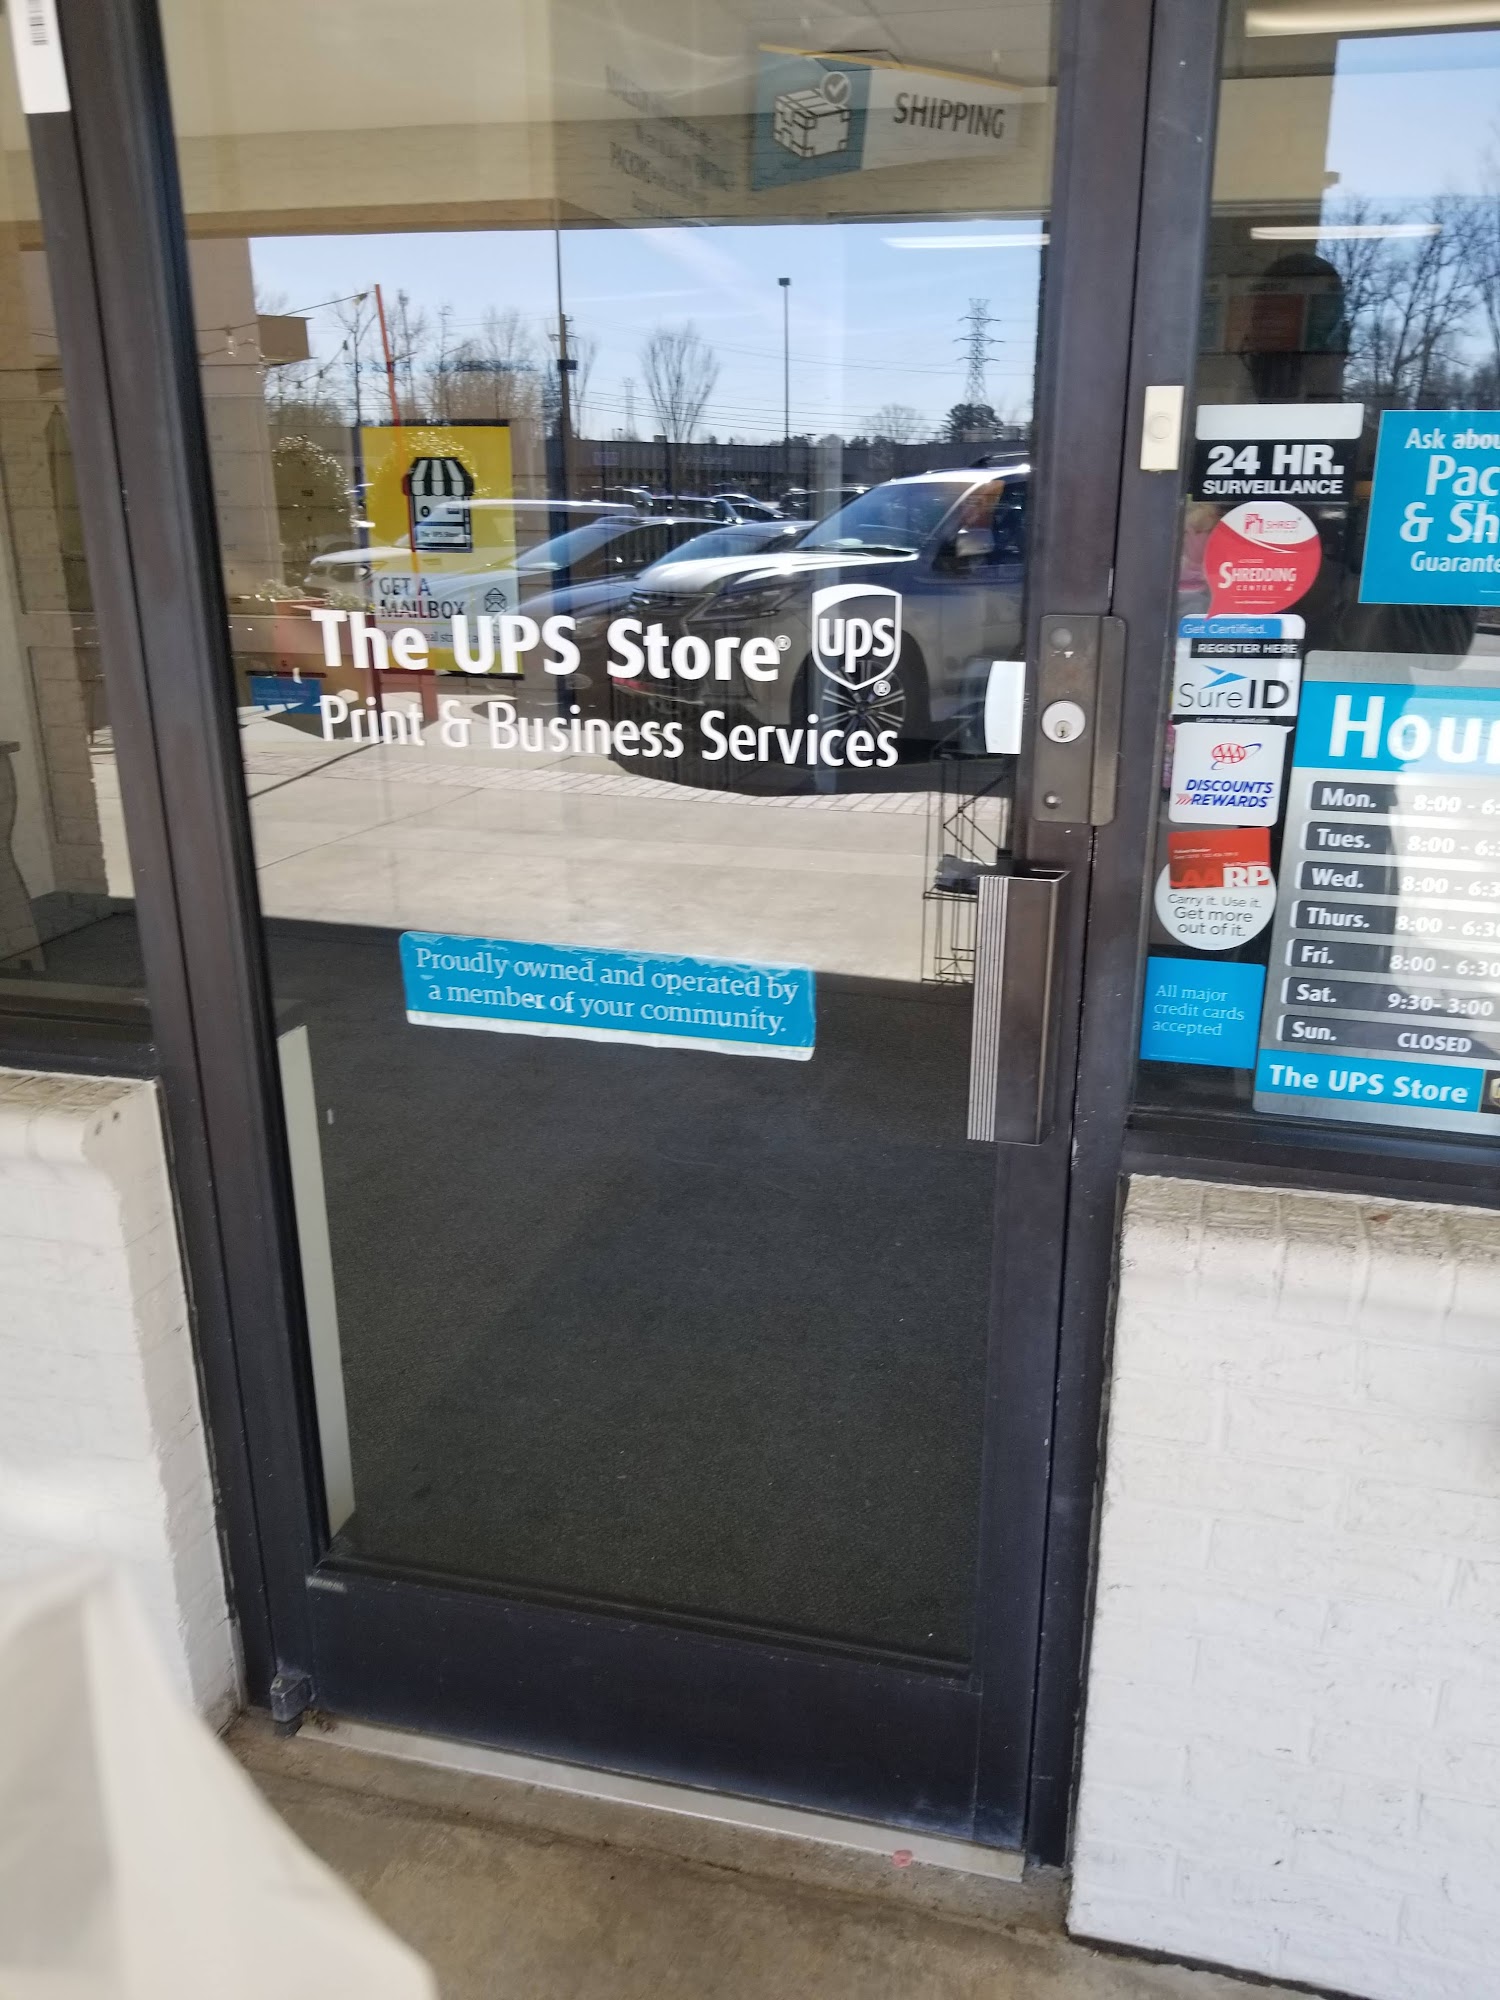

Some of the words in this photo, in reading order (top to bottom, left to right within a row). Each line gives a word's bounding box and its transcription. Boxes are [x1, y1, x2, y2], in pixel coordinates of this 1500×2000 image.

[894, 92, 1006, 140] SHIPPING
[1404, 428, 1445, 449] Ask
[1206, 446, 1261, 475] 24
[1271, 444, 1344, 475] HR.
[1202, 478, 1344, 496] SURVEILLANCE
[1399, 501, 1434, 543] &
[379, 577, 411, 596] GET
[418, 578, 431, 596] A
[1218, 561, 1297, 589] SHREDDING
[1236, 584, 1274, 592] CENTER
[380, 600, 465, 619] MAILBOX
[1182, 623, 1206, 634] Get
[1208, 623, 1268, 635] Certified.
[312, 609, 429, 671] The
[451, 614, 580, 676] UPS
[818, 617, 896, 673] ups
[1197, 643, 1260, 654] REGISTER
[1263, 644, 1298, 655] HERE
[1178, 679, 1290, 709] SureID
[320, 695, 425, 747] Print
[441, 699, 472, 748] &
[489, 702, 685, 758] Business
[701, 711, 899, 768] Services
[1213, 744, 1245, 764] AAA
[1186, 779, 1274, 794] DISCOUNTS
[1190, 794, 1268, 808] REWARDS
[1321, 787, 1377, 808] Mon.
[1413, 794, 1462, 813] 8:00
[1317, 828, 1371, 849] Tues.
[1407, 835, 1456, 853] 8:00
[1312, 868, 1364, 889] Wed.
[1401, 876, 1449, 894] 8:00
[1167, 893, 1202, 907] Carry
[1205, 895, 1218, 907] it.
[1221, 897, 1246, 908] Use
[1249, 897, 1262, 908] it.
[1174, 906, 1204, 920] Get
[1207, 911, 1253, 923] more
[1307, 907, 1370, 928] Thurs.
[1395, 915, 1443, 933] 8:00
[1178, 923, 1205, 935] out
[1210, 922, 1229, 936] of
[1231, 924, 1246, 937] it.
[1300, 945, 1335, 965] Fri.
[1390, 954, 1437, 972] 8:00
[1456, 960, 1500, 977] 6:30
[416, 948, 510, 979] Proudly
[513, 959, 595, 983] owned
[600, 964, 645, 988] and
[651, 970, 763, 999] operated
[766, 976, 800, 1005] by
[1155, 984, 1179, 998] All
[1181, 987, 1228, 1003] major
[1296, 983, 1337, 1003] Sat.
[1447, 998, 1494, 1016] 3:00
[428, 984, 443, 1000] a
[447, 983, 546, 1010] member
[549, 990, 576, 1013] of
[578, 997, 635, 1019] your
[640, 1002, 787, 1036] community.
[1154, 1003, 1198, 1017] credit
[1202, 1006, 1245, 1020] cards
[1152, 1021, 1223, 1036] accepted
[1292, 1021, 1337, 1041] Sun.
[1397, 1033, 1472, 1053] CLOSED
[1269, 1065, 1319, 1089] The
[1328, 1070, 1384, 1095] UPS
[1393, 1076, 1469, 1104] Store
